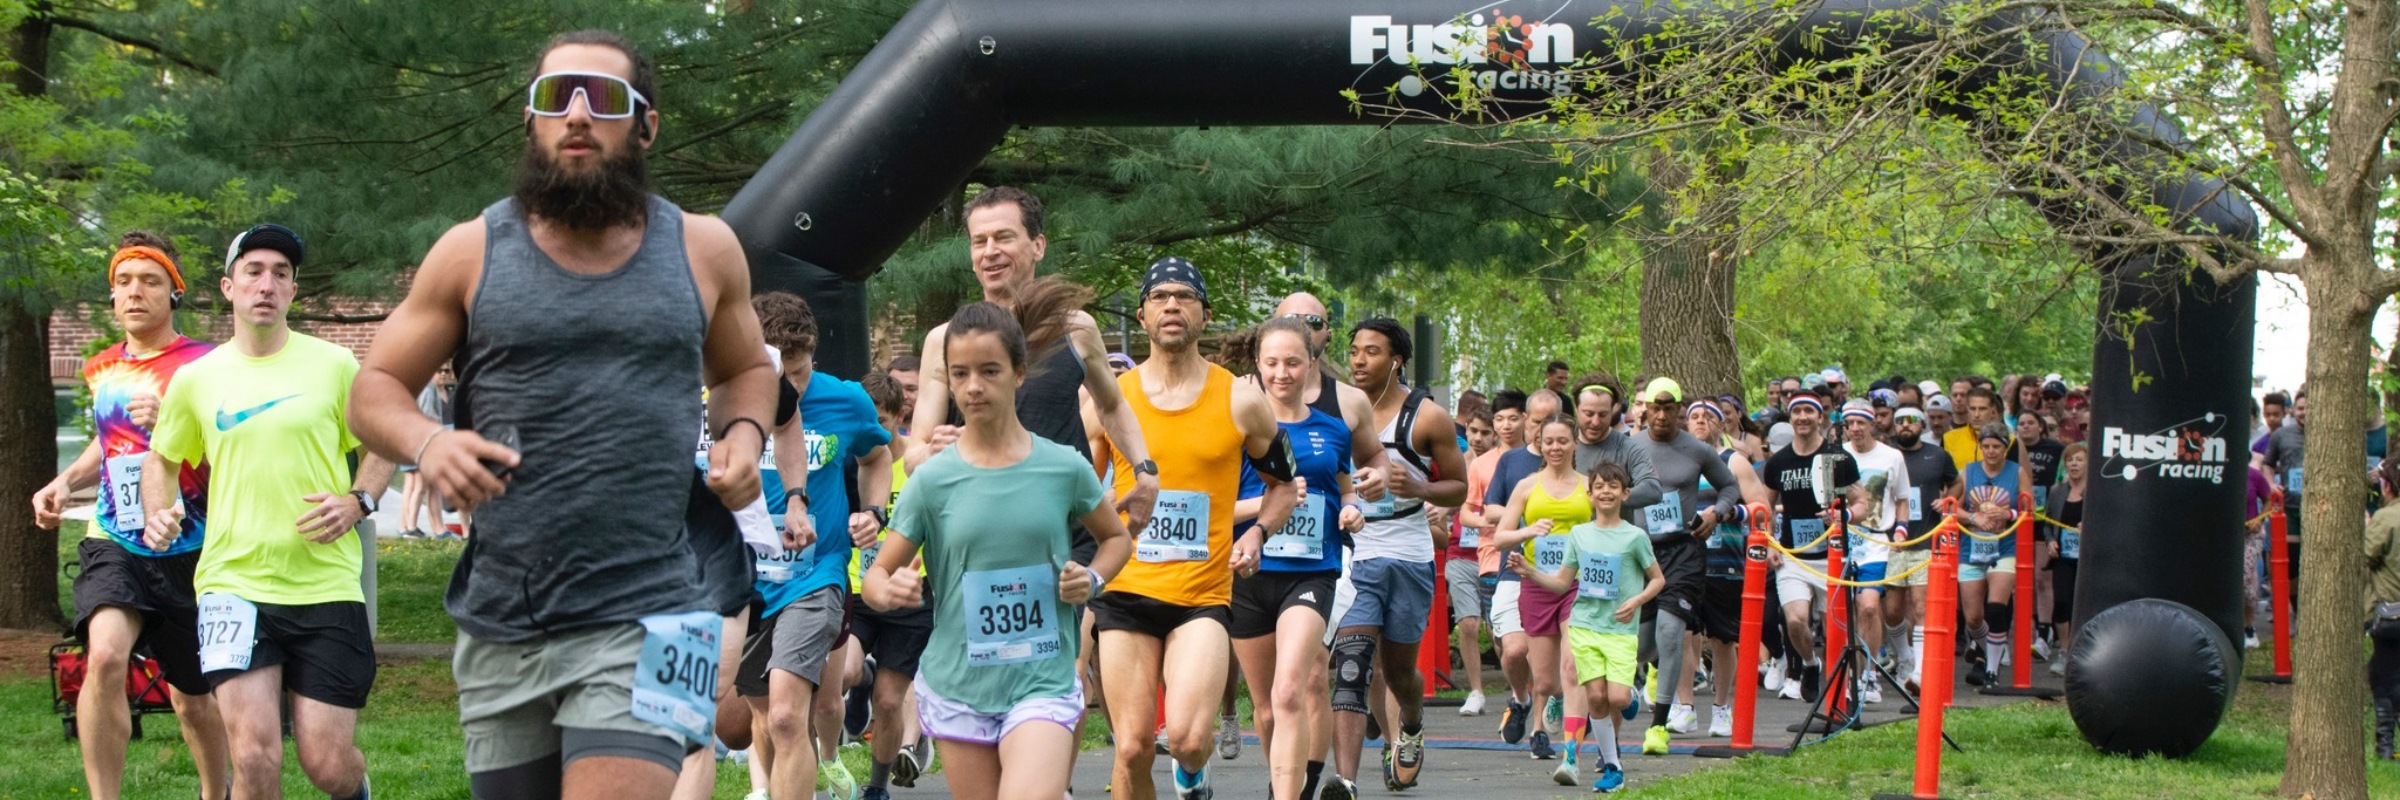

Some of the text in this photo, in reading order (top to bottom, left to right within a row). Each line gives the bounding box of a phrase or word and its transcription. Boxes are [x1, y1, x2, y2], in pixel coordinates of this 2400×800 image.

[1351, 13, 1574, 64] Fusion
[1467, 69, 1573, 97] racing
[2102, 427, 2226, 462] Fusion
[2029, 452, 2054, 463] ROIT
[2159, 463, 2224, 484] racing
[121, 481, 140, 507] 37
[1651, 506, 1678, 522] 3841
[1149, 516, 1197, 541] 3840
[1188, 549, 1208, 559] 3840
[1541, 551, 1563, 565] 339
[1583, 567, 1613, 585] 3393
[991, 582, 1027, 593] Fusion
[979, 599, 1044, 635] 3394
[199, 620, 242, 648] 3727
[1037, 639, 1059, 654] 3394
[230, 654, 250, 665] 3727
